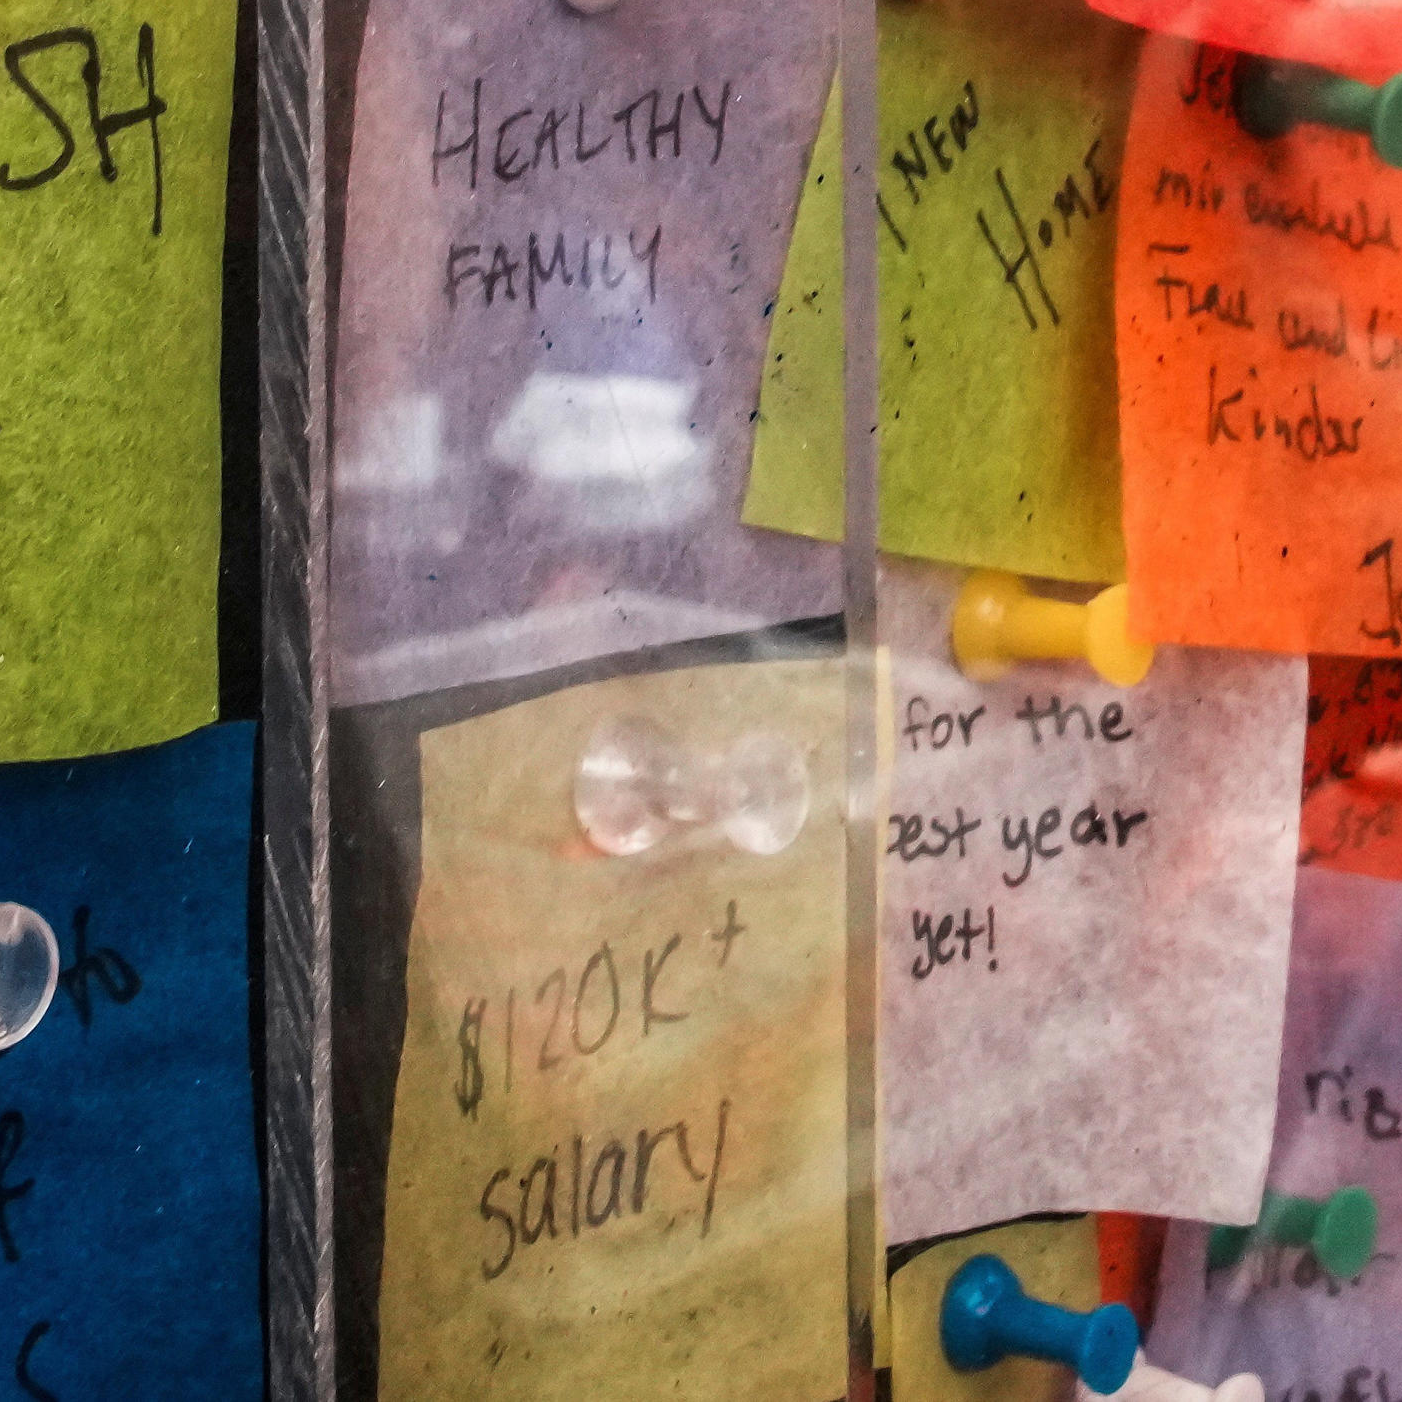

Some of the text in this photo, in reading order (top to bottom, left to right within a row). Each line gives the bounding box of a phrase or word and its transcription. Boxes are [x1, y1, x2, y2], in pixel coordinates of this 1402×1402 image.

[431, 76, 732, 190] HEALTHY
[890, 79, 980, 205] NEW
[444, 224, 662, 312] FAMILY
[903, 694, 1133, 751] for the
[1001, 801, 1148, 889] year
[910, 904, 998, 980] yet!
